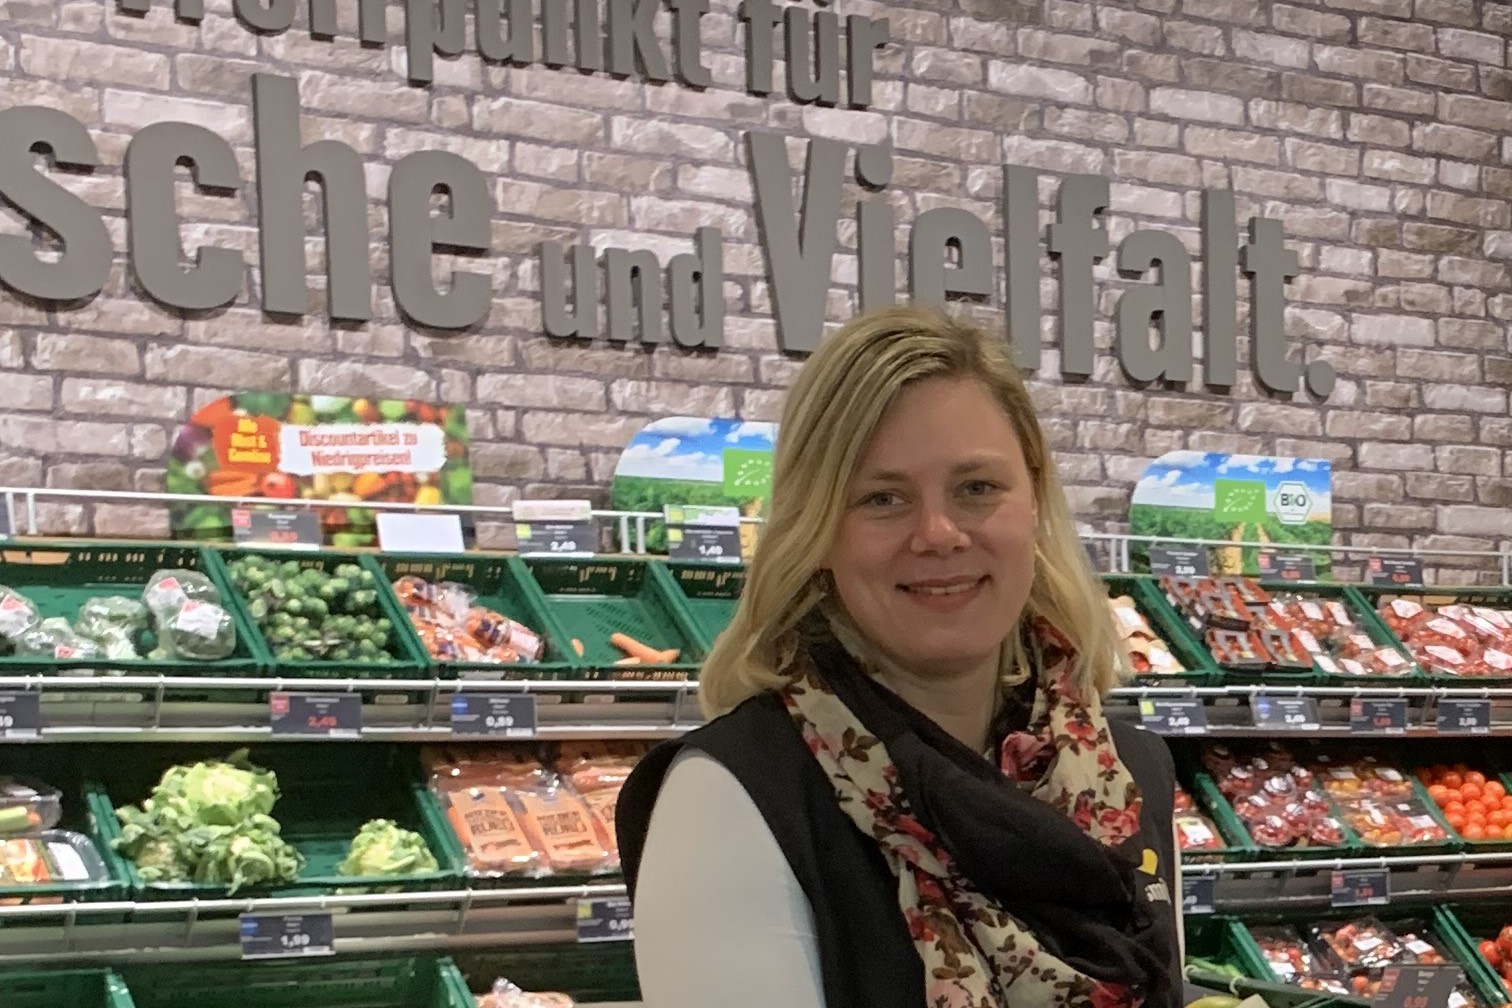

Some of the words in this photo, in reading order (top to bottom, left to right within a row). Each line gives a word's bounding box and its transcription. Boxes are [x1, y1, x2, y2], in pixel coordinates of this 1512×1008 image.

[738, 0, 890, 108] für
[538, 227, 725, 352] und
[743, 130, 1338, 400] Vielfalt.
